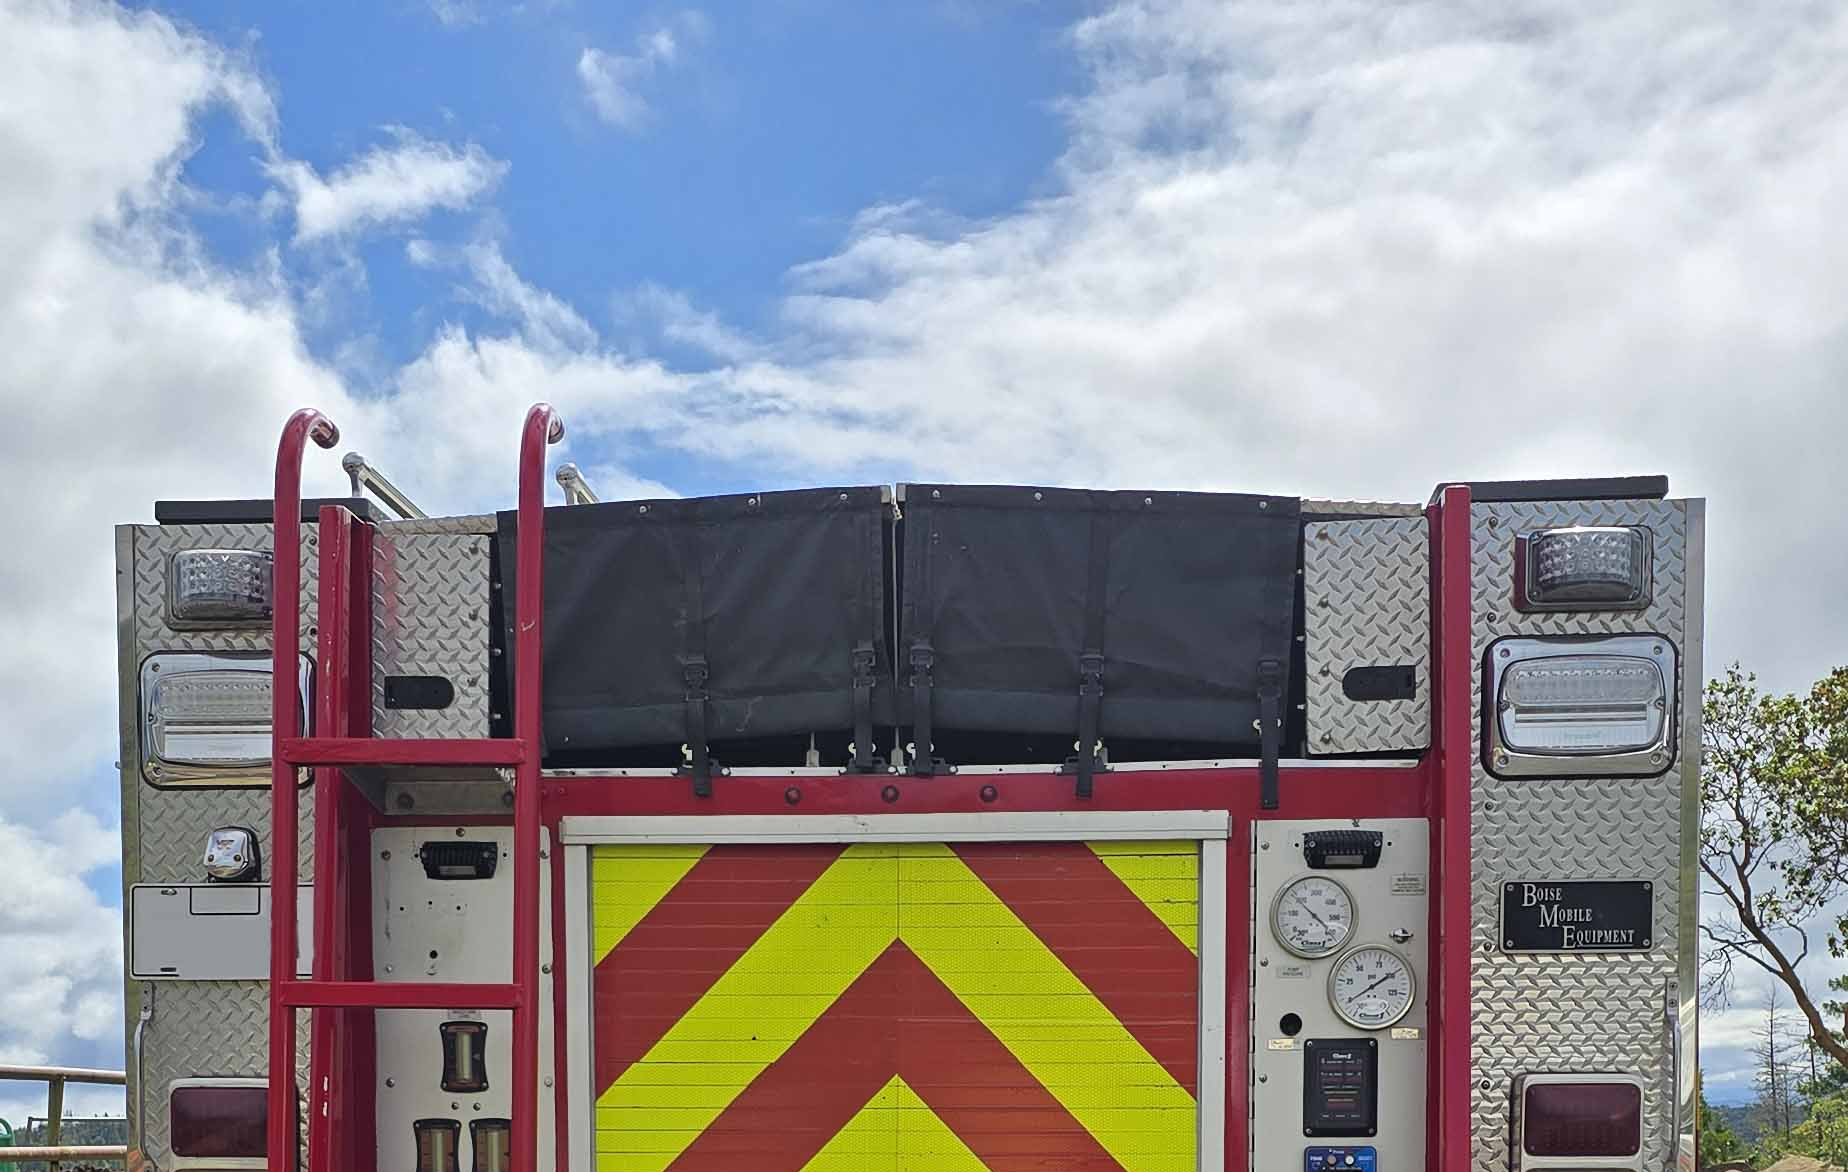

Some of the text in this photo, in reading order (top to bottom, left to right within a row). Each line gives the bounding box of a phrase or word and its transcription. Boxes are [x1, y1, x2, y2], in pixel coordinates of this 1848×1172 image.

[1521, 883, 1562, 907] BOISE
[1539, 904, 1593, 928] MOBILE
[1562, 925, 1635, 949] EQUIPMENT
